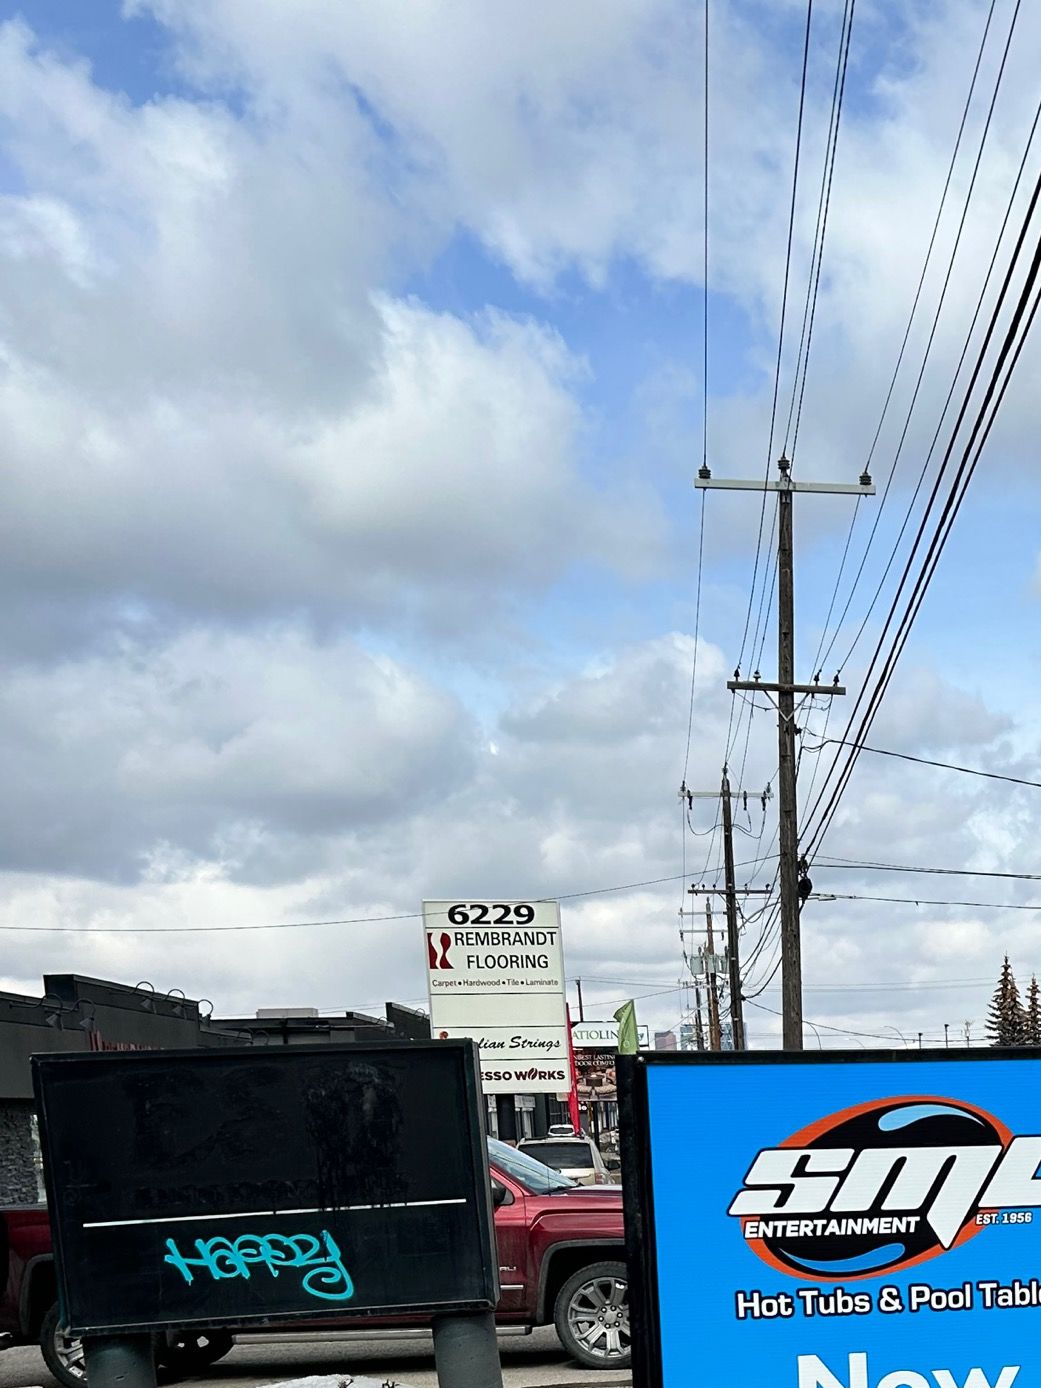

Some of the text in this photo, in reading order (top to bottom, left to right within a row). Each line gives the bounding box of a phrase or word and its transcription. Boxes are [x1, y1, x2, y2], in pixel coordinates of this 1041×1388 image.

[447, 904, 535, 925] 6229
[454, 931, 557, 946] REMBRANDT
[467, 954, 549, 969] FLOORING
[432, 980, 457, 988] Carpet
[509, 1036, 561, 1052] Strings
[514, 1067, 566, 1081] WORKS
[975, 1212, 1033, 1226] EST. 1956
[744, 1216, 920, 1239] ENTERTAINMENT
[737, 1291, 793, 1318] Hot
[798, 1287, 871, 1315] Tubs
[879, 1286, 902, 1311] &
[910, 1283, 971, 1311] Pool
